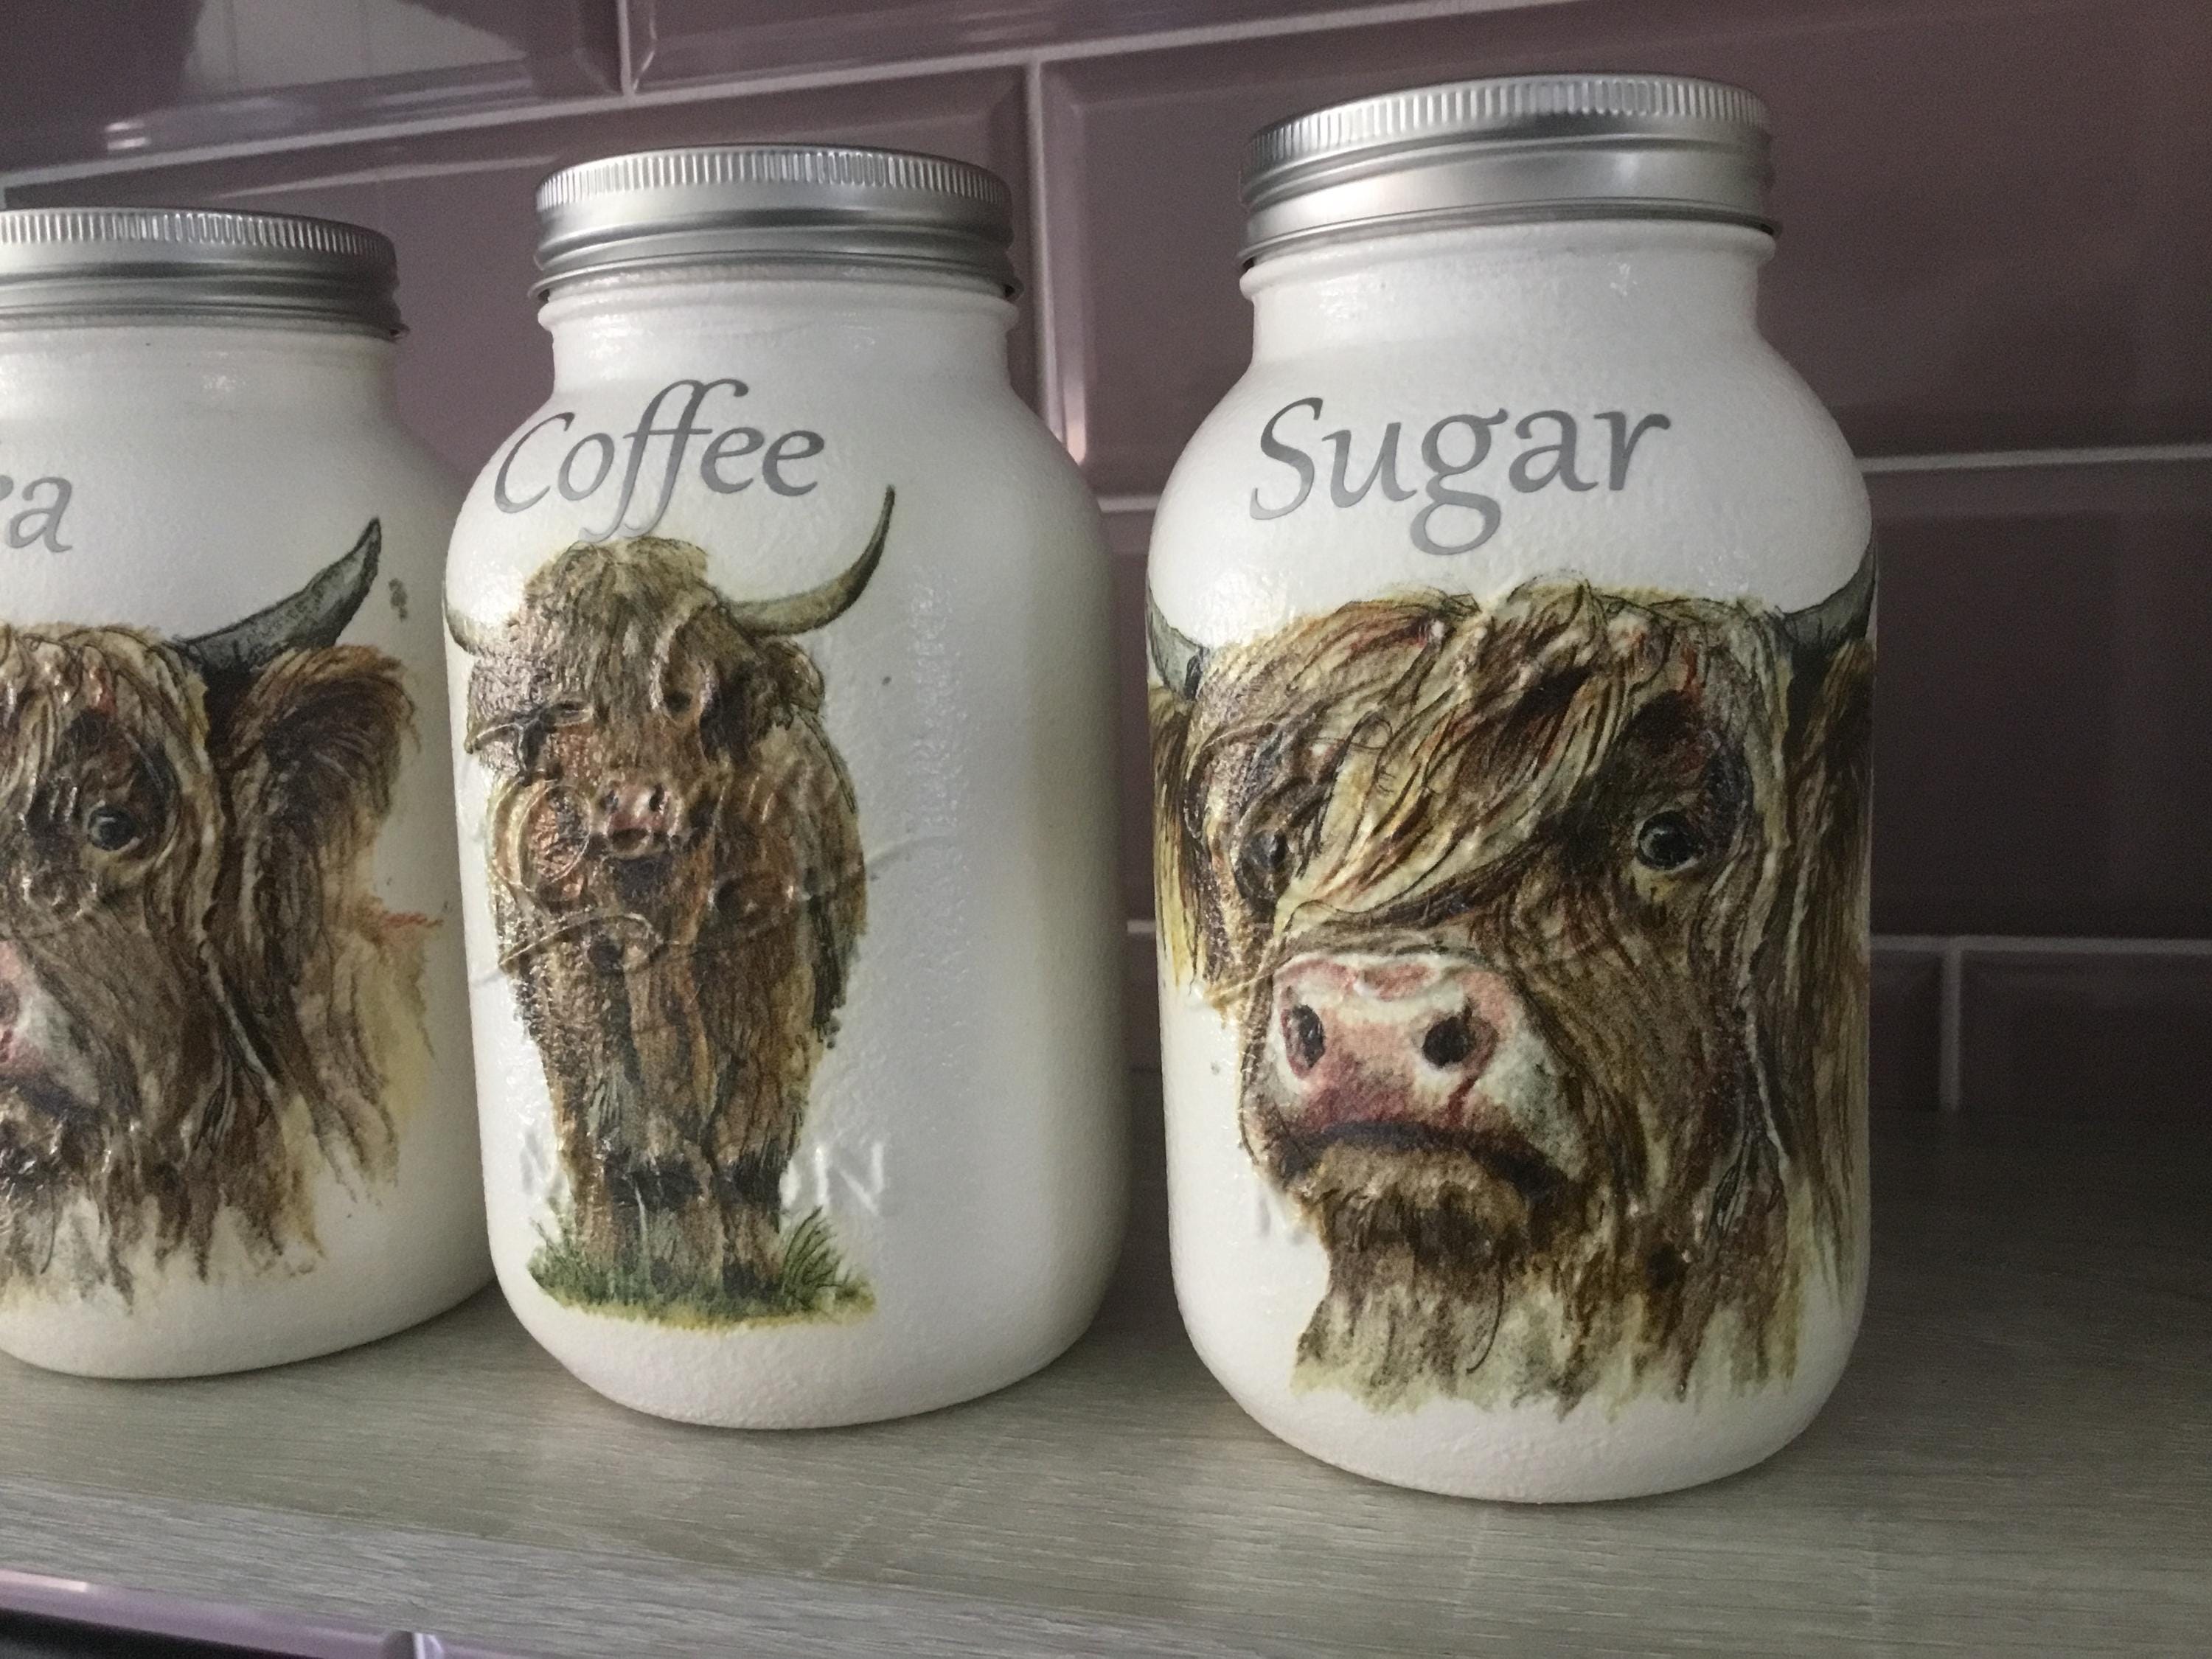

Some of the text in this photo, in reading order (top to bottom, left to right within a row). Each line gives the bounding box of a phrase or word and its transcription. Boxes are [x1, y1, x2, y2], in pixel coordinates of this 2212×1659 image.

[0, 474, 73, 553] a
[494, 378, 824, 542] Coffee
[1250, 397, 1672, 555] Sugar
